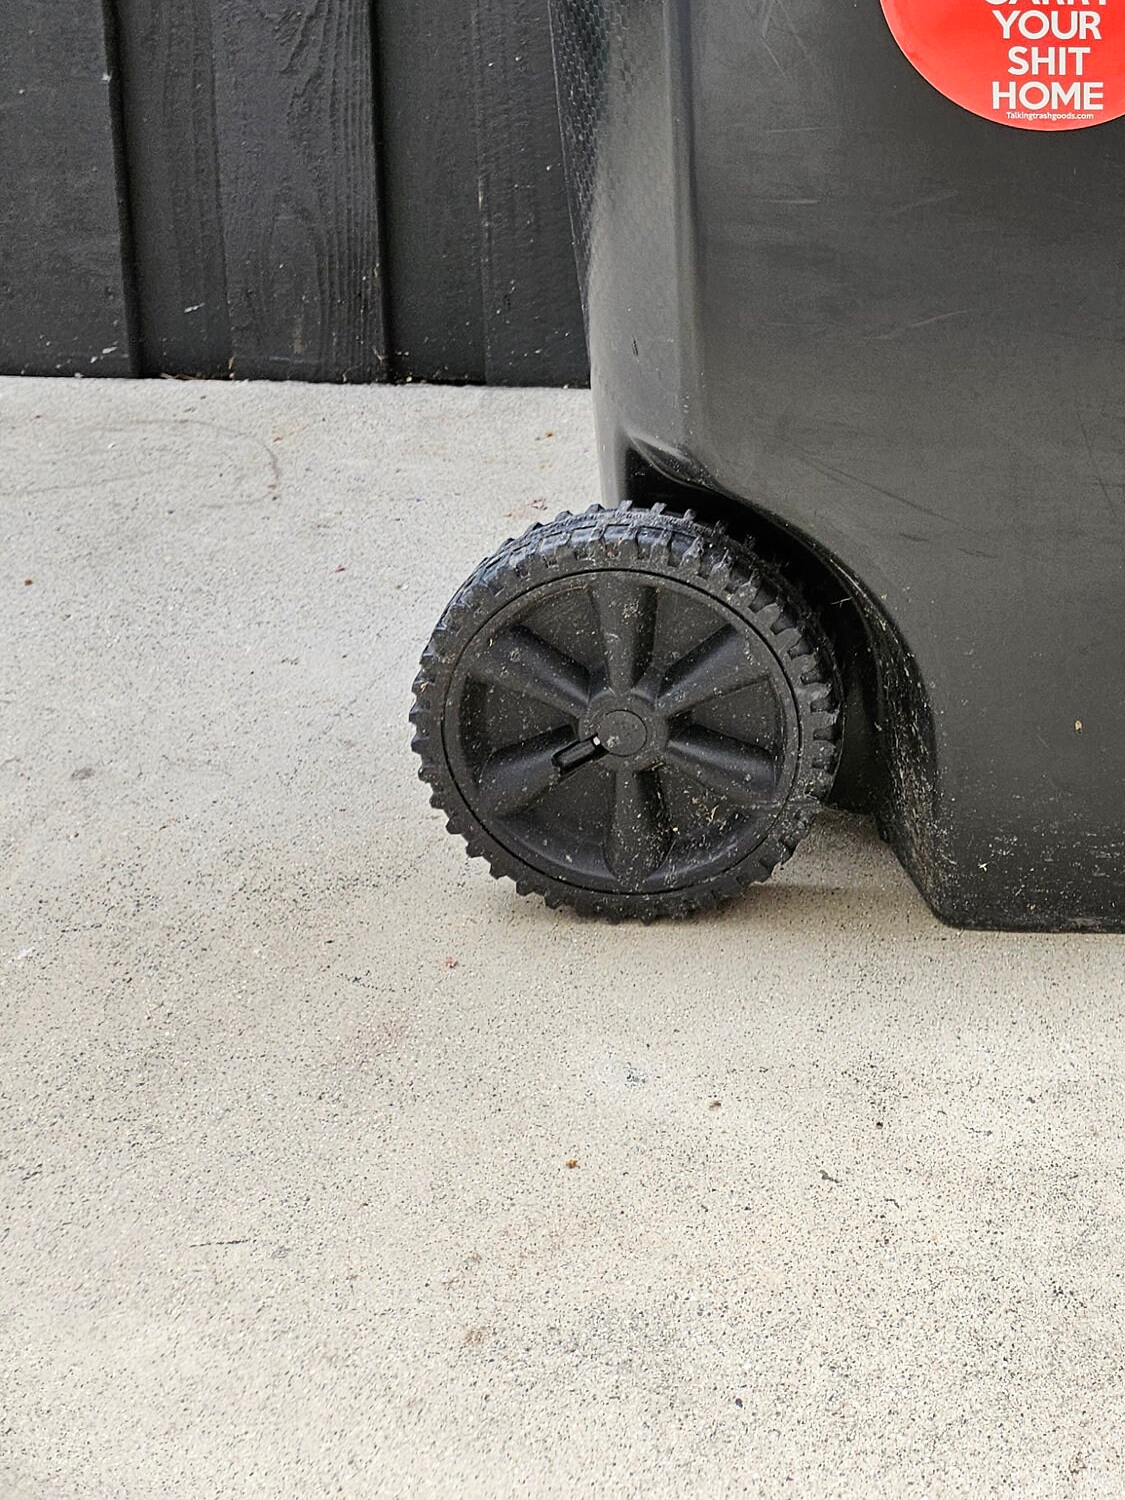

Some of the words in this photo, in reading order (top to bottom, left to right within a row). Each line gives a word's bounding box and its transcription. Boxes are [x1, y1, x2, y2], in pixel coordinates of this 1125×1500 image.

[992, 10, 1101, 39] YOUR
[1008, 46, 1090, 75] SHIT
[992, 81, 1103, 110] HOME
[1005, 111, 1095, 121] Talkingtrashgoods.com
